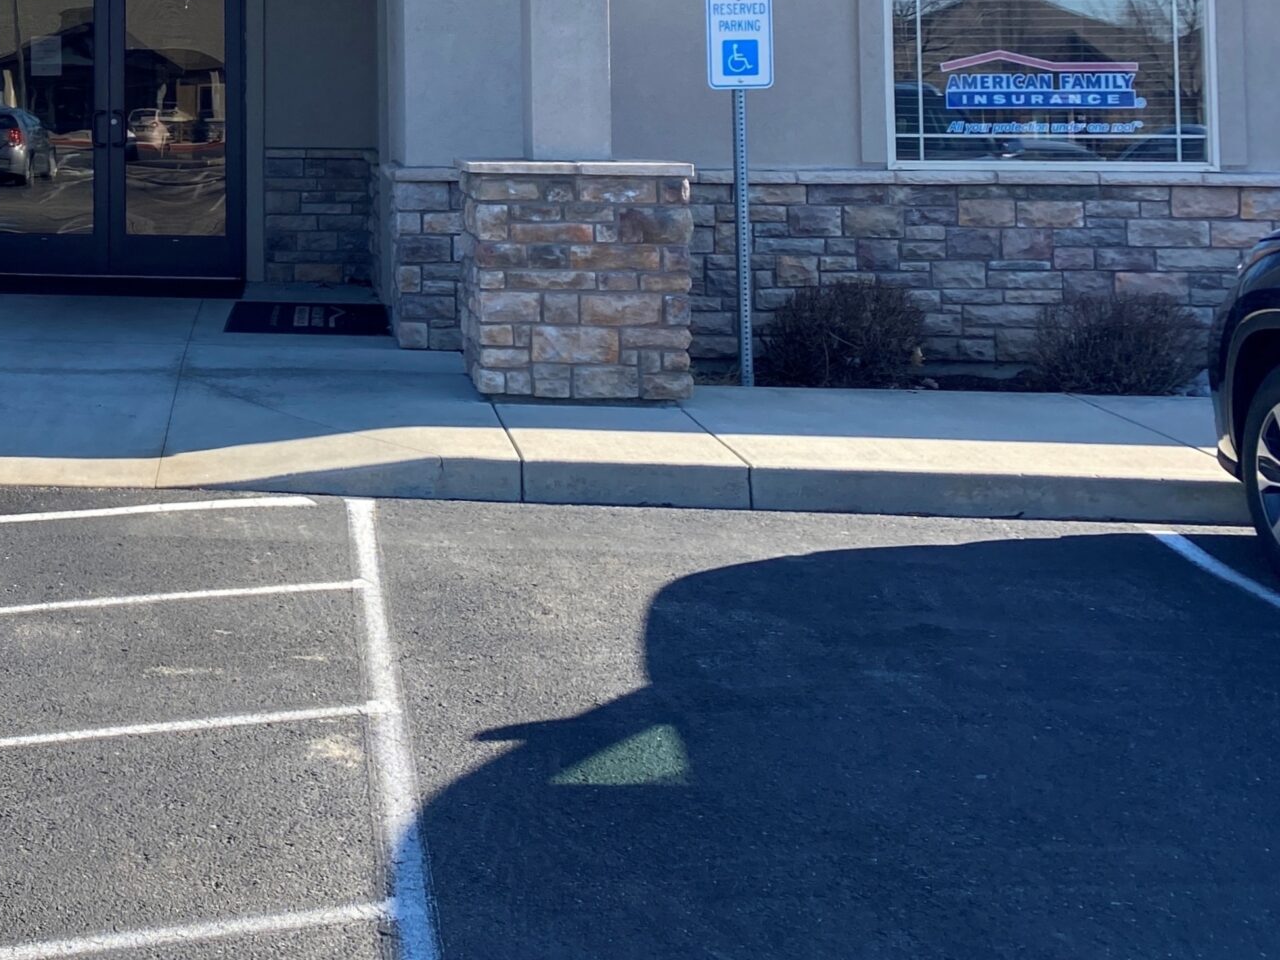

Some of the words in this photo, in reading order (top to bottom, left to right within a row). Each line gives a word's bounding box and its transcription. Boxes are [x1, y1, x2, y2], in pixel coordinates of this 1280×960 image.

[713, 3, 766, 16] RESERVED
[719, 19, 761, 32] PARKING
[947, 74, 1053, 90] AMERICAN
[1060, 74, 1135, 90] FAMILY
[962, 94, 1120, 104] INSURANCE
[964, 123, 992, 135] your
[1086, 123, 1110, 133] one
